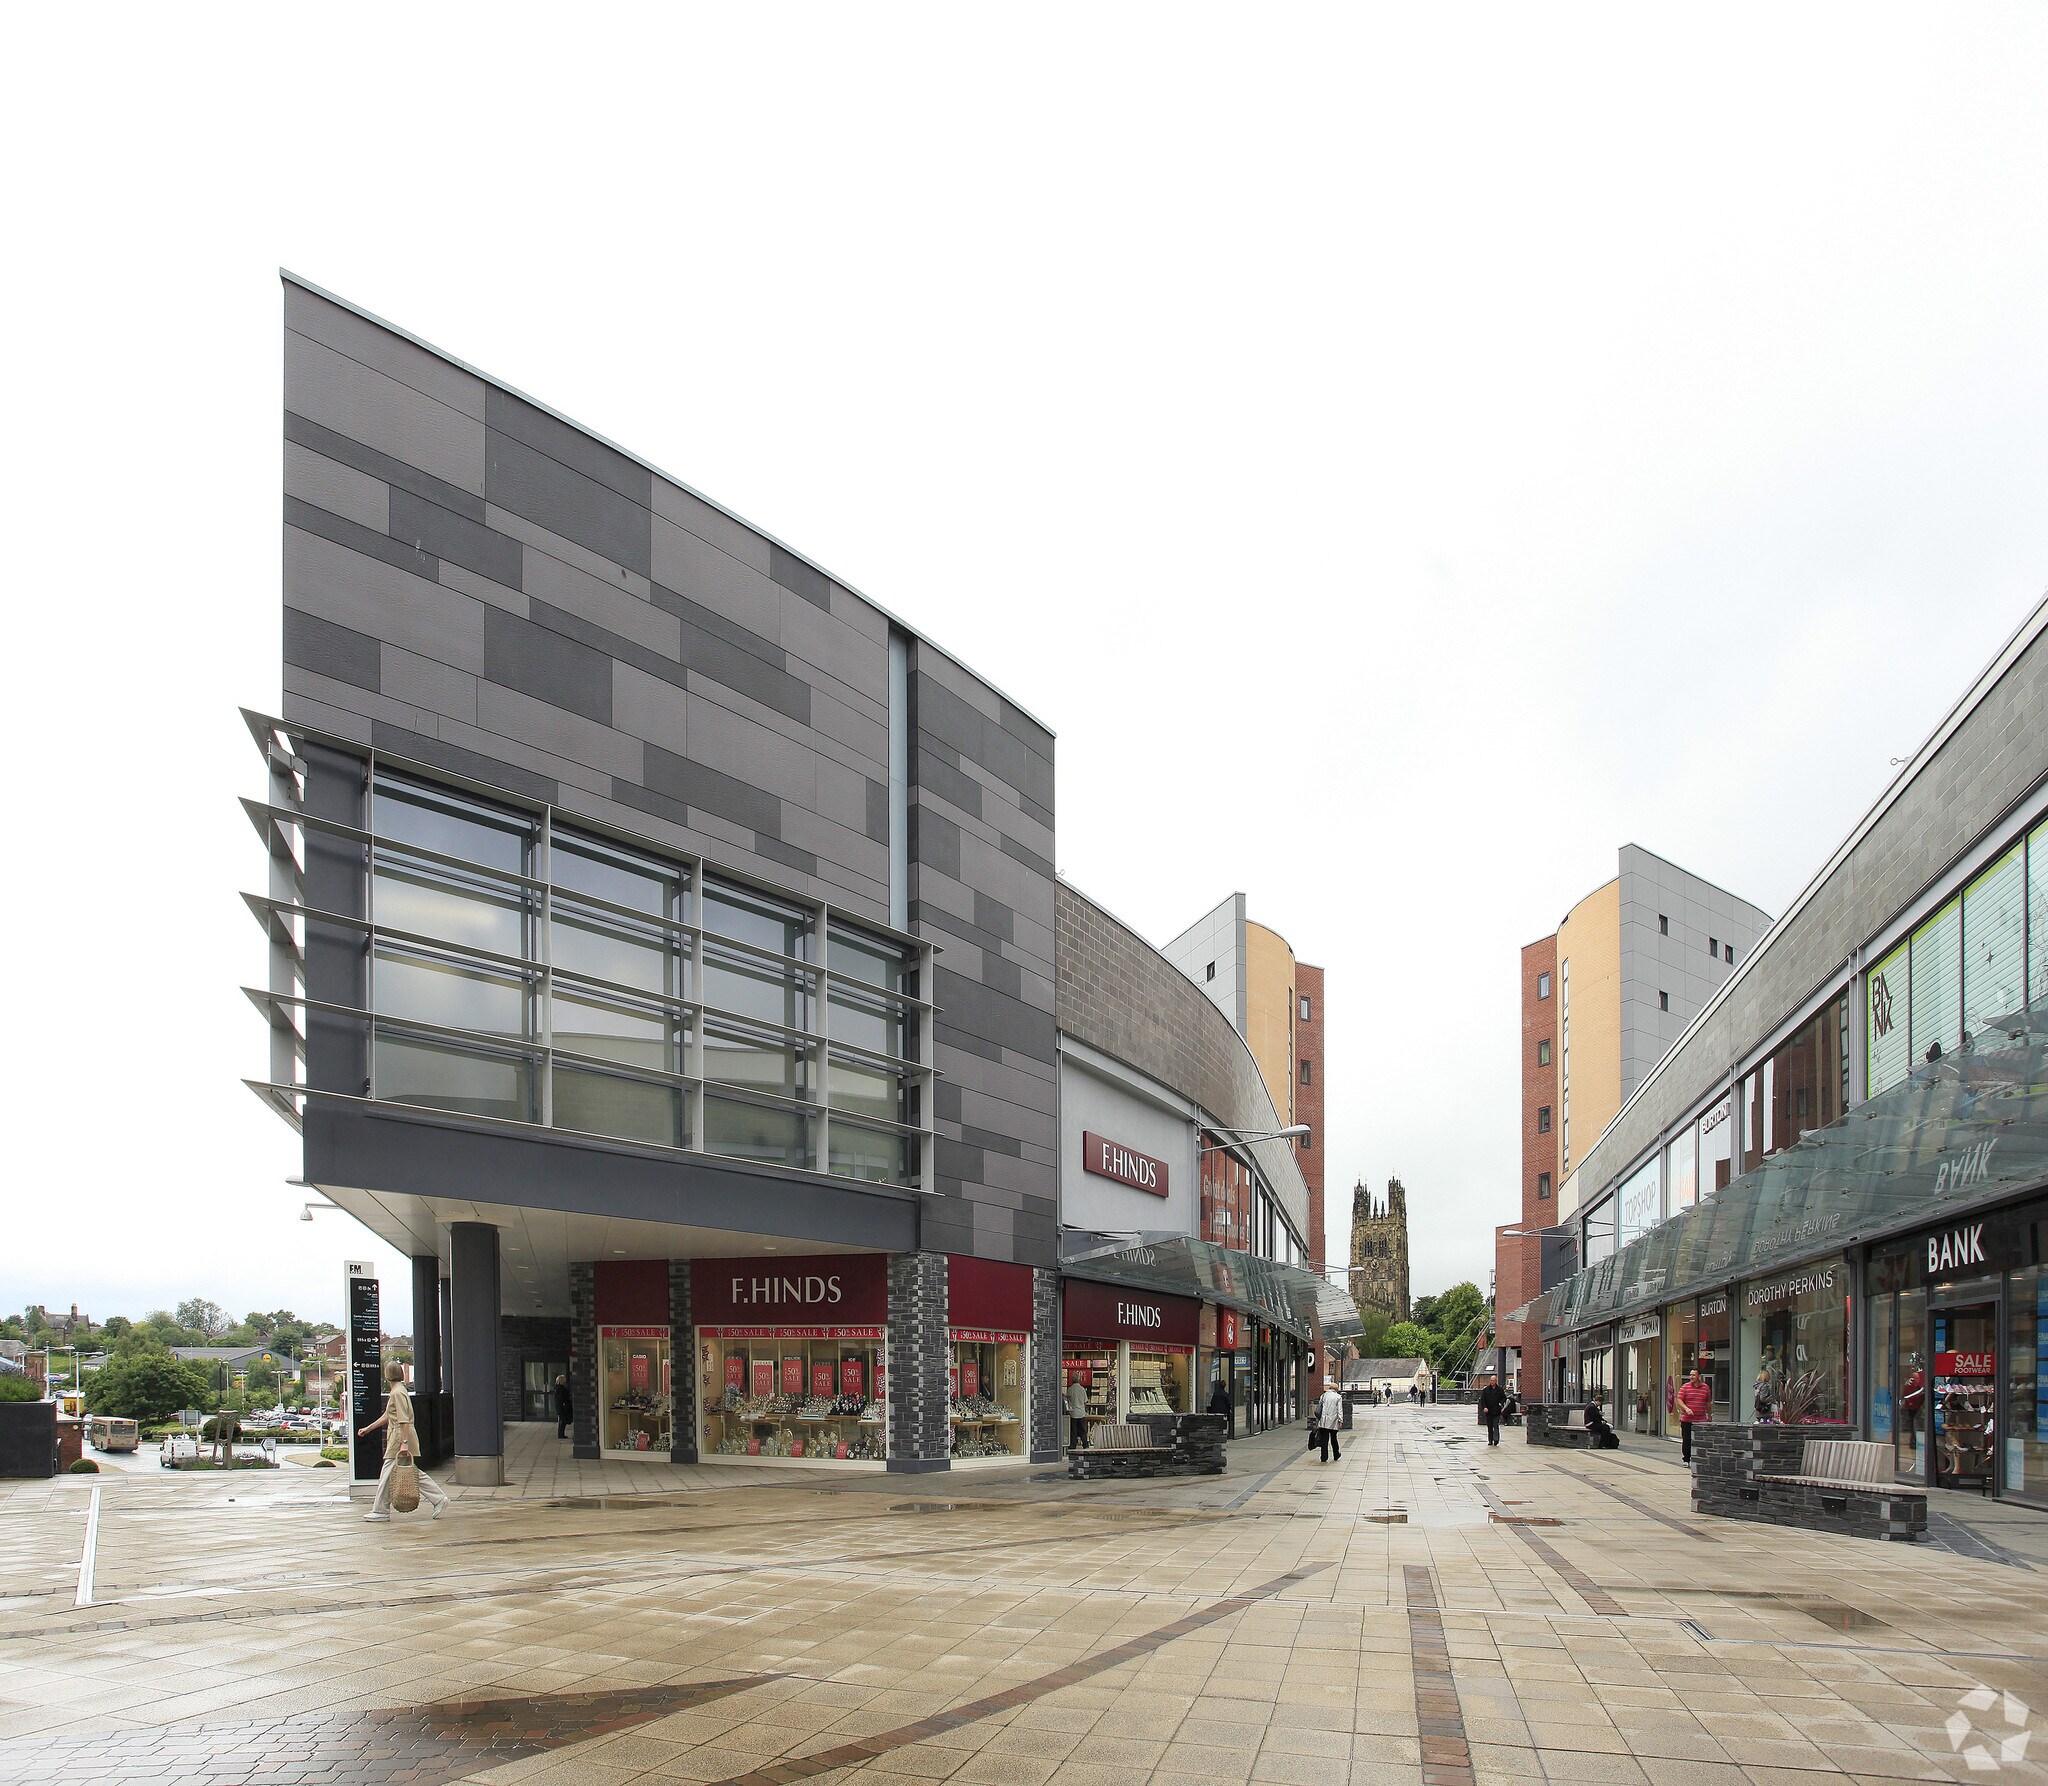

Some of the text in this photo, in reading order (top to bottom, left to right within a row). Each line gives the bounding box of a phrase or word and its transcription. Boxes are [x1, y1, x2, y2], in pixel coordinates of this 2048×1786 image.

[1102, 1142, 1156, 1188] F.HINDS
[1624, 1180, 1656, 1226] TOPSHOP
[1928, 1223, 1984, 1272] BANK
[732, 1276, 842, 1304] F.HINDS
[1748, 1270, 1833, 1306] DOROTHY PERKINS
[1118, 1302, 1161, 1328] F.HINDS
[1702, 1300, 1726, 1316] BURTON
[636, 1328, 656, 1336] SALE
[744, 1328, 764, 1336] SALE
[796, 1328, 818, 1336] SALE
[852, 1328, 873, 1336] SALE
[972, 1332, 988, 1340] SALE
[1955, 1354, 1992, 1368] SALE
[1874, 1402, 1890, 1417] FINAL
